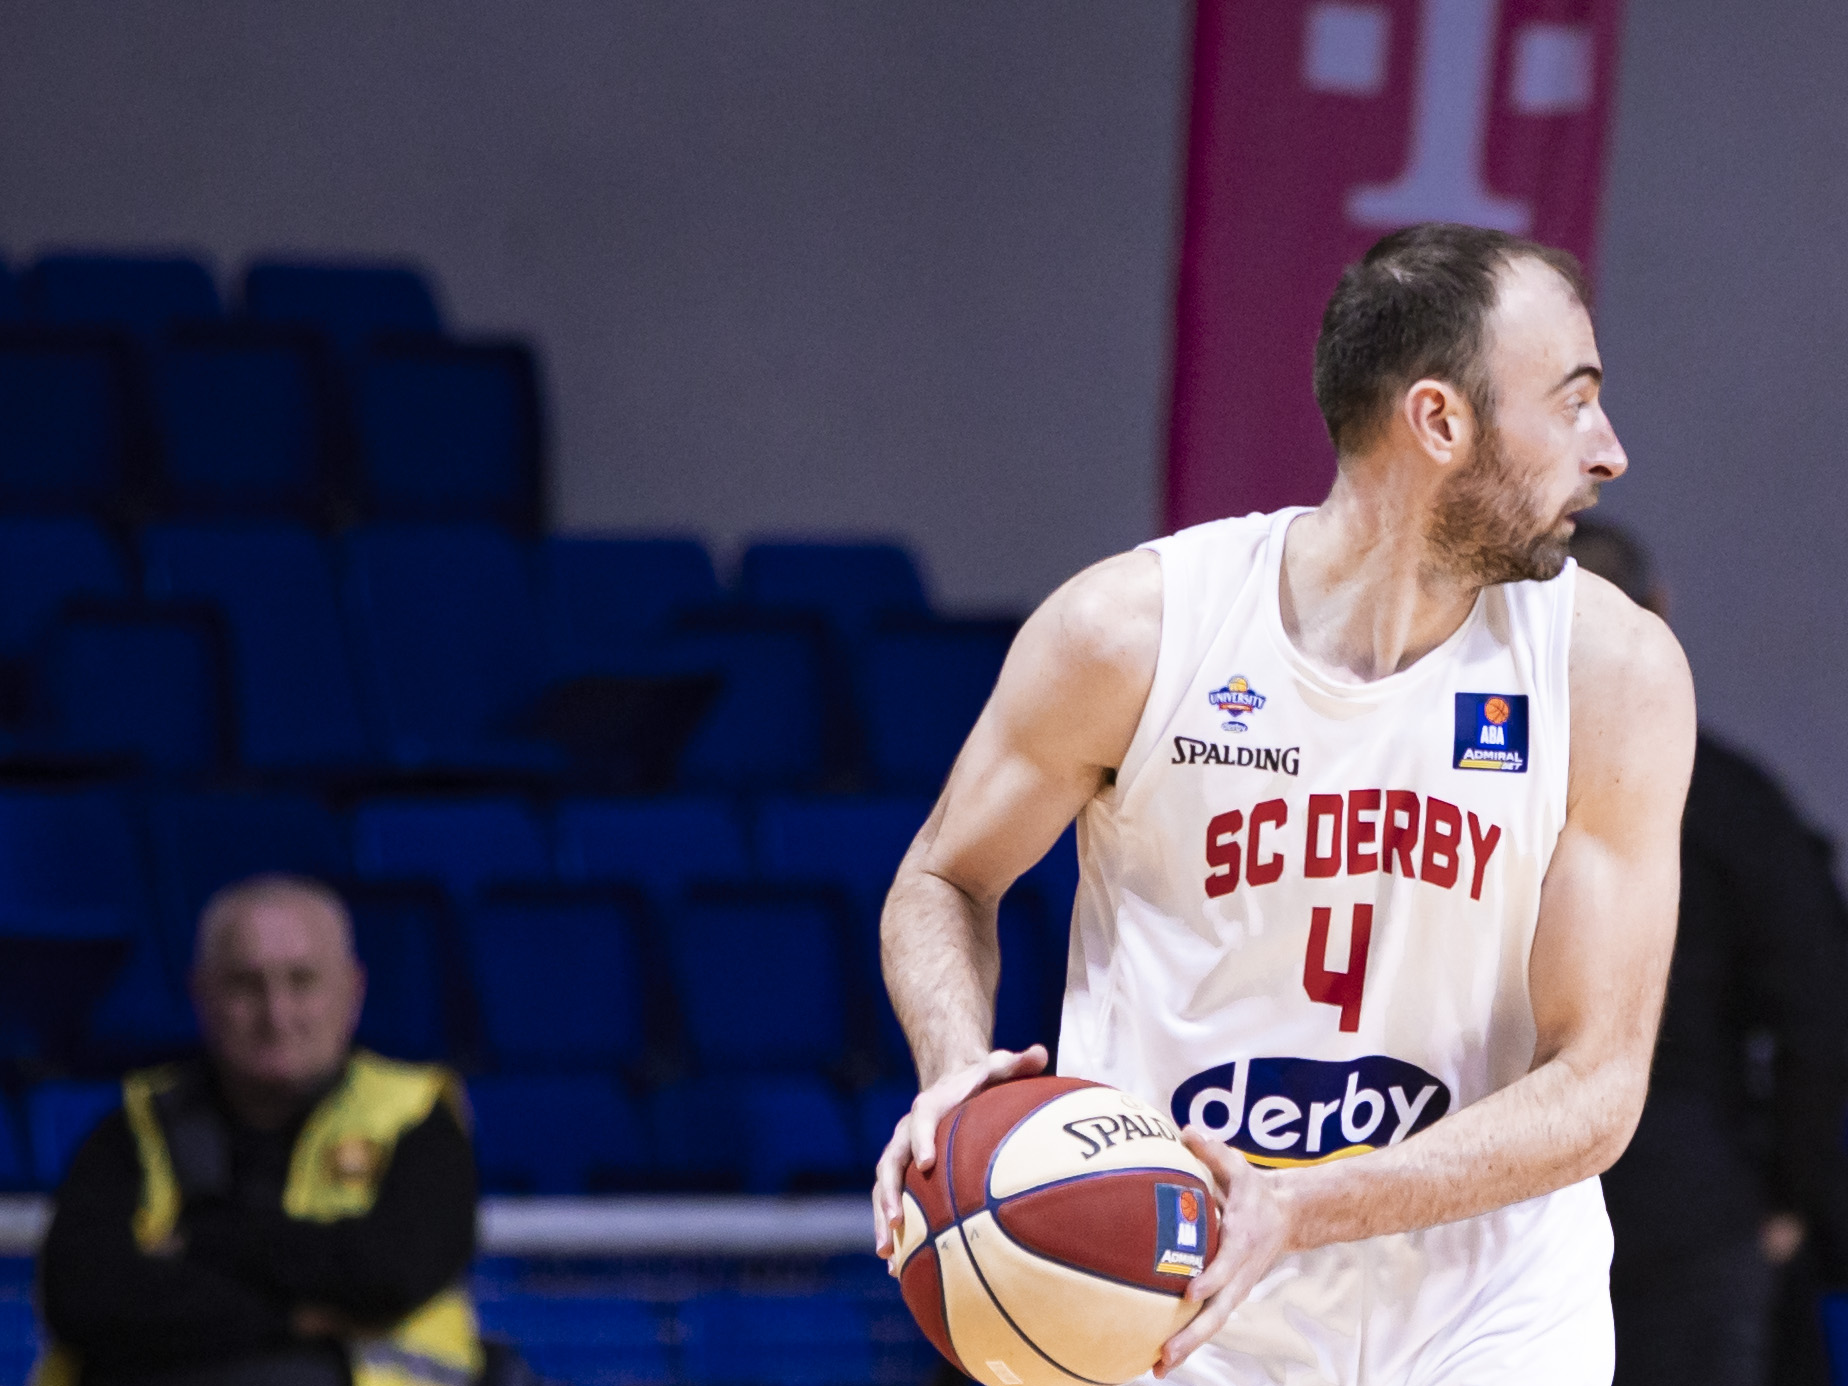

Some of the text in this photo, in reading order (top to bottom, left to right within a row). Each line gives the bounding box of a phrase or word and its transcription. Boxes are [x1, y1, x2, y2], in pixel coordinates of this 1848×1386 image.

[1209, 691, 1266, 709] UNIVERSITY
[1463, 748, 1523, 763] ADMIRAL
[1480, 725, 1505, 745] ABA
[1171, 736, 1300, 777] SPALDING
[1204, 789, 1501, 901] SC DERBY
[1303, 903, 1373, 1034] 4
[1189, 1058, 1439, 1153] derby
